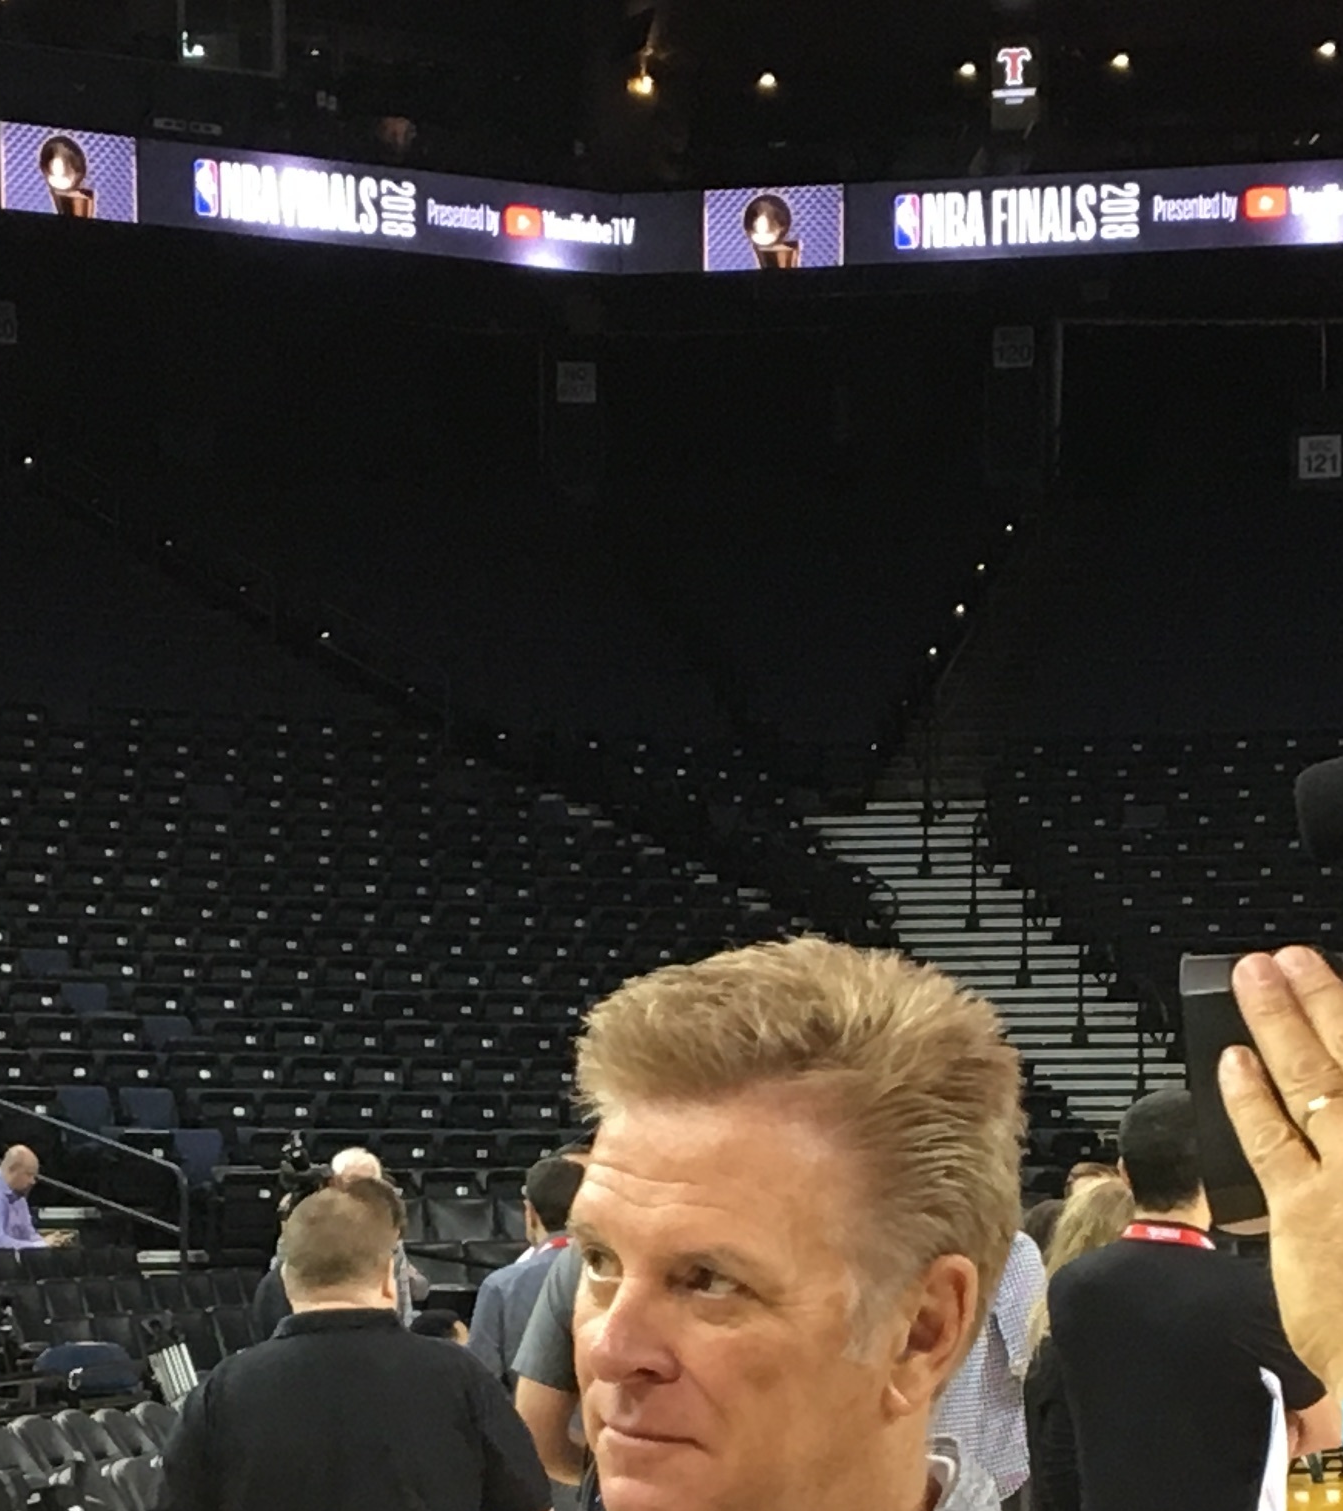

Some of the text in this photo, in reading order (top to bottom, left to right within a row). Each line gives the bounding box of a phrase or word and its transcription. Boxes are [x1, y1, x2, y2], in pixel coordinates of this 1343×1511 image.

[219, 161, 281, 226] NBA
[380, 178, 417, 238] 2018
[425, 197, 501, 237] Presented by
[921, 176, 1141, 250] NBA FINALS 2018
[1152, 190, 1239, 223] Presented by
[1305, 453, 1338, 473] 121
